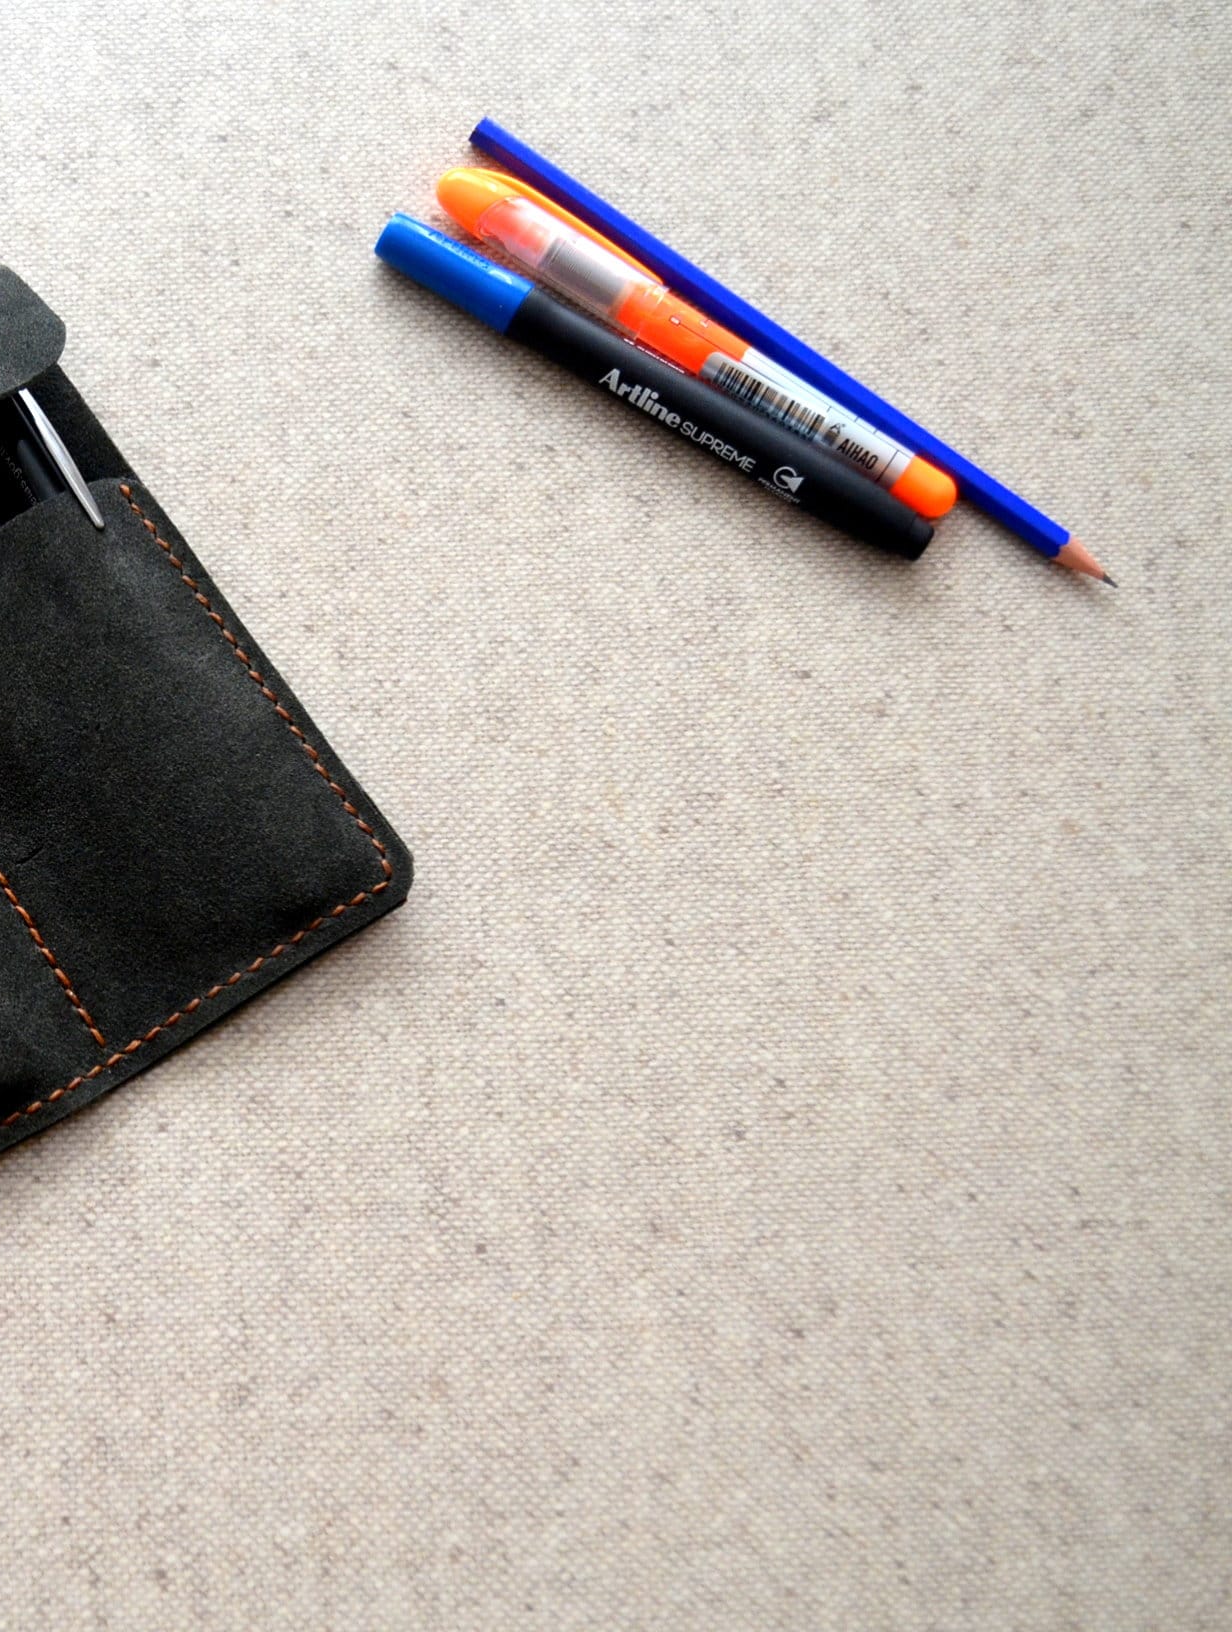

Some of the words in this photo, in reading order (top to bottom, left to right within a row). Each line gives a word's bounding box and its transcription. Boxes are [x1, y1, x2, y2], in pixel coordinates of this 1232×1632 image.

[598, 368, 682, 428] Artline
[679, 420, 757, 473] SUPREME
[836, 438, 880, 471] AIHAO
